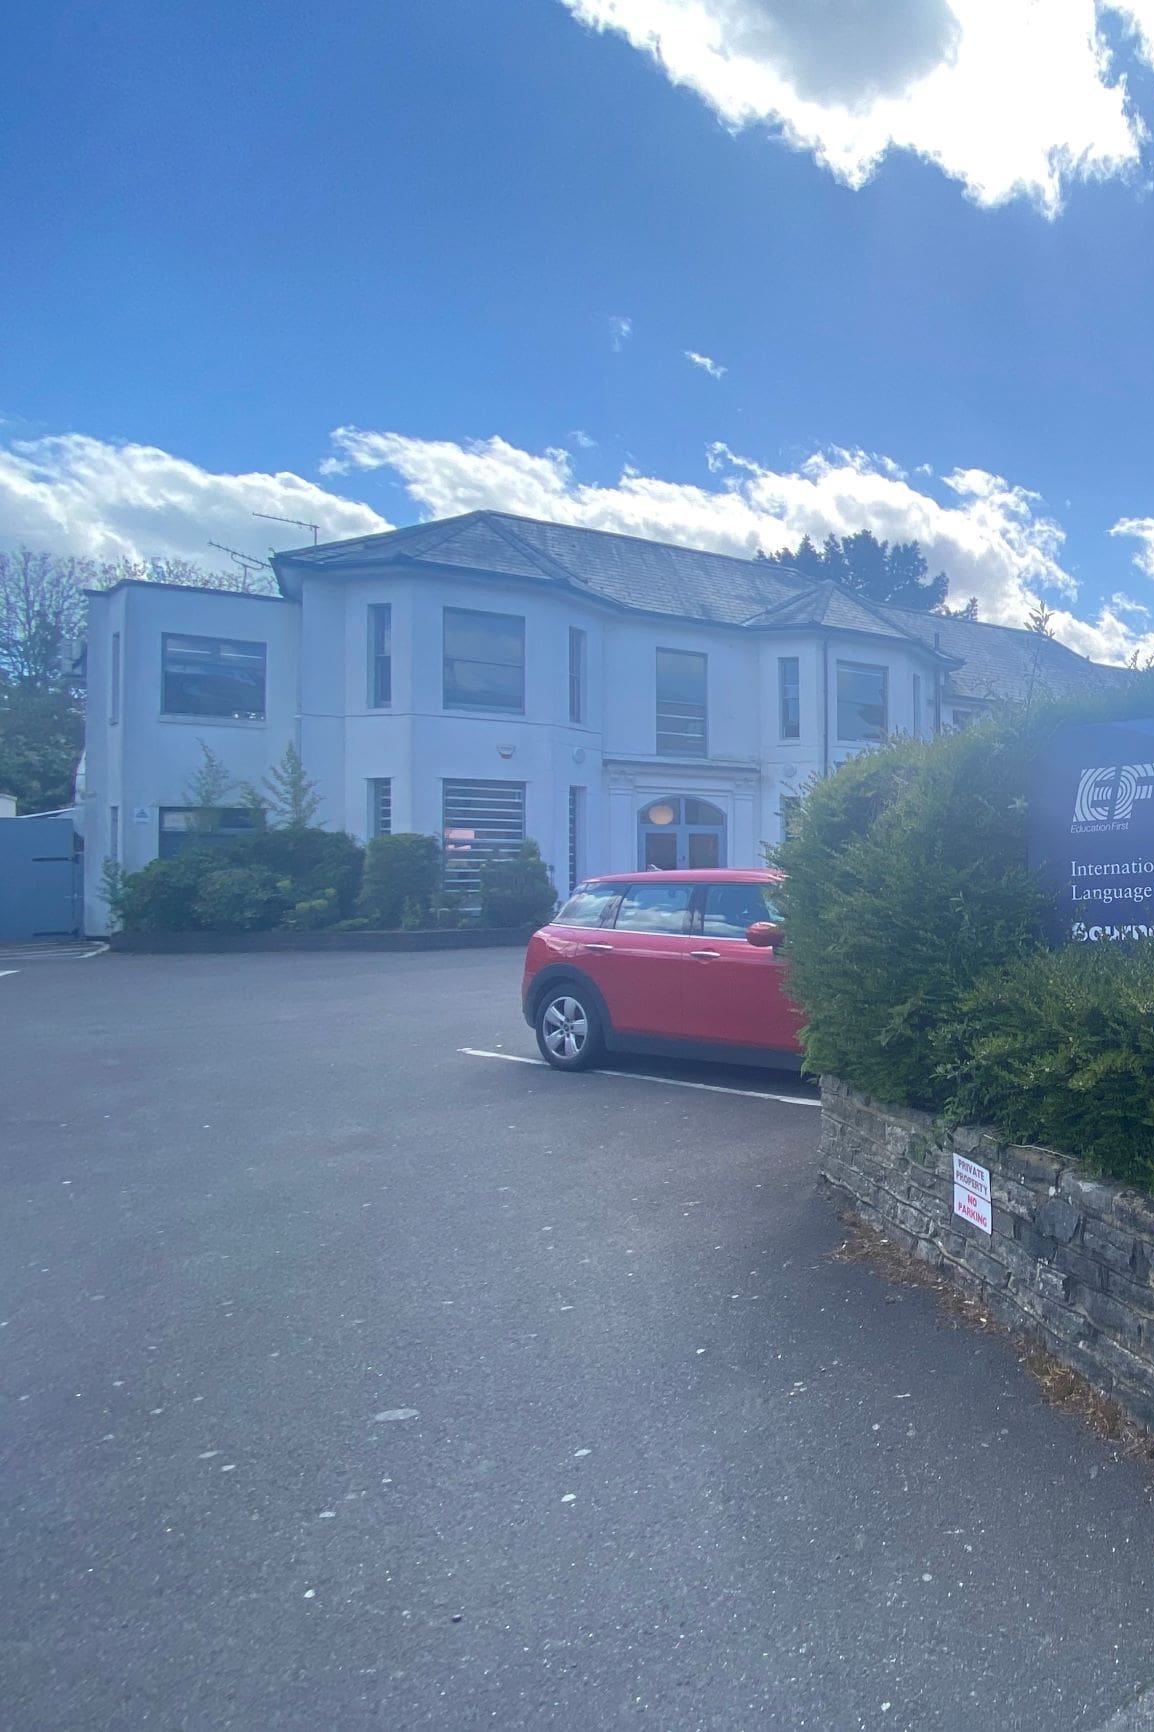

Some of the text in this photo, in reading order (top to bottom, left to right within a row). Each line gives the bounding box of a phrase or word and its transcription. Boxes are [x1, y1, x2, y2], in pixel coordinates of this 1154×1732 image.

[1070, 820, 1129, 834] Education First
[1071, 884, 1152, 903] Language
[958, 1159, 984, 1181] PRIVATE
[956, 1170, 988, 1195] PROPERTY
[967, 1194, 977, 1207] NO
[958, 1202, 988, 1227] PARKING
